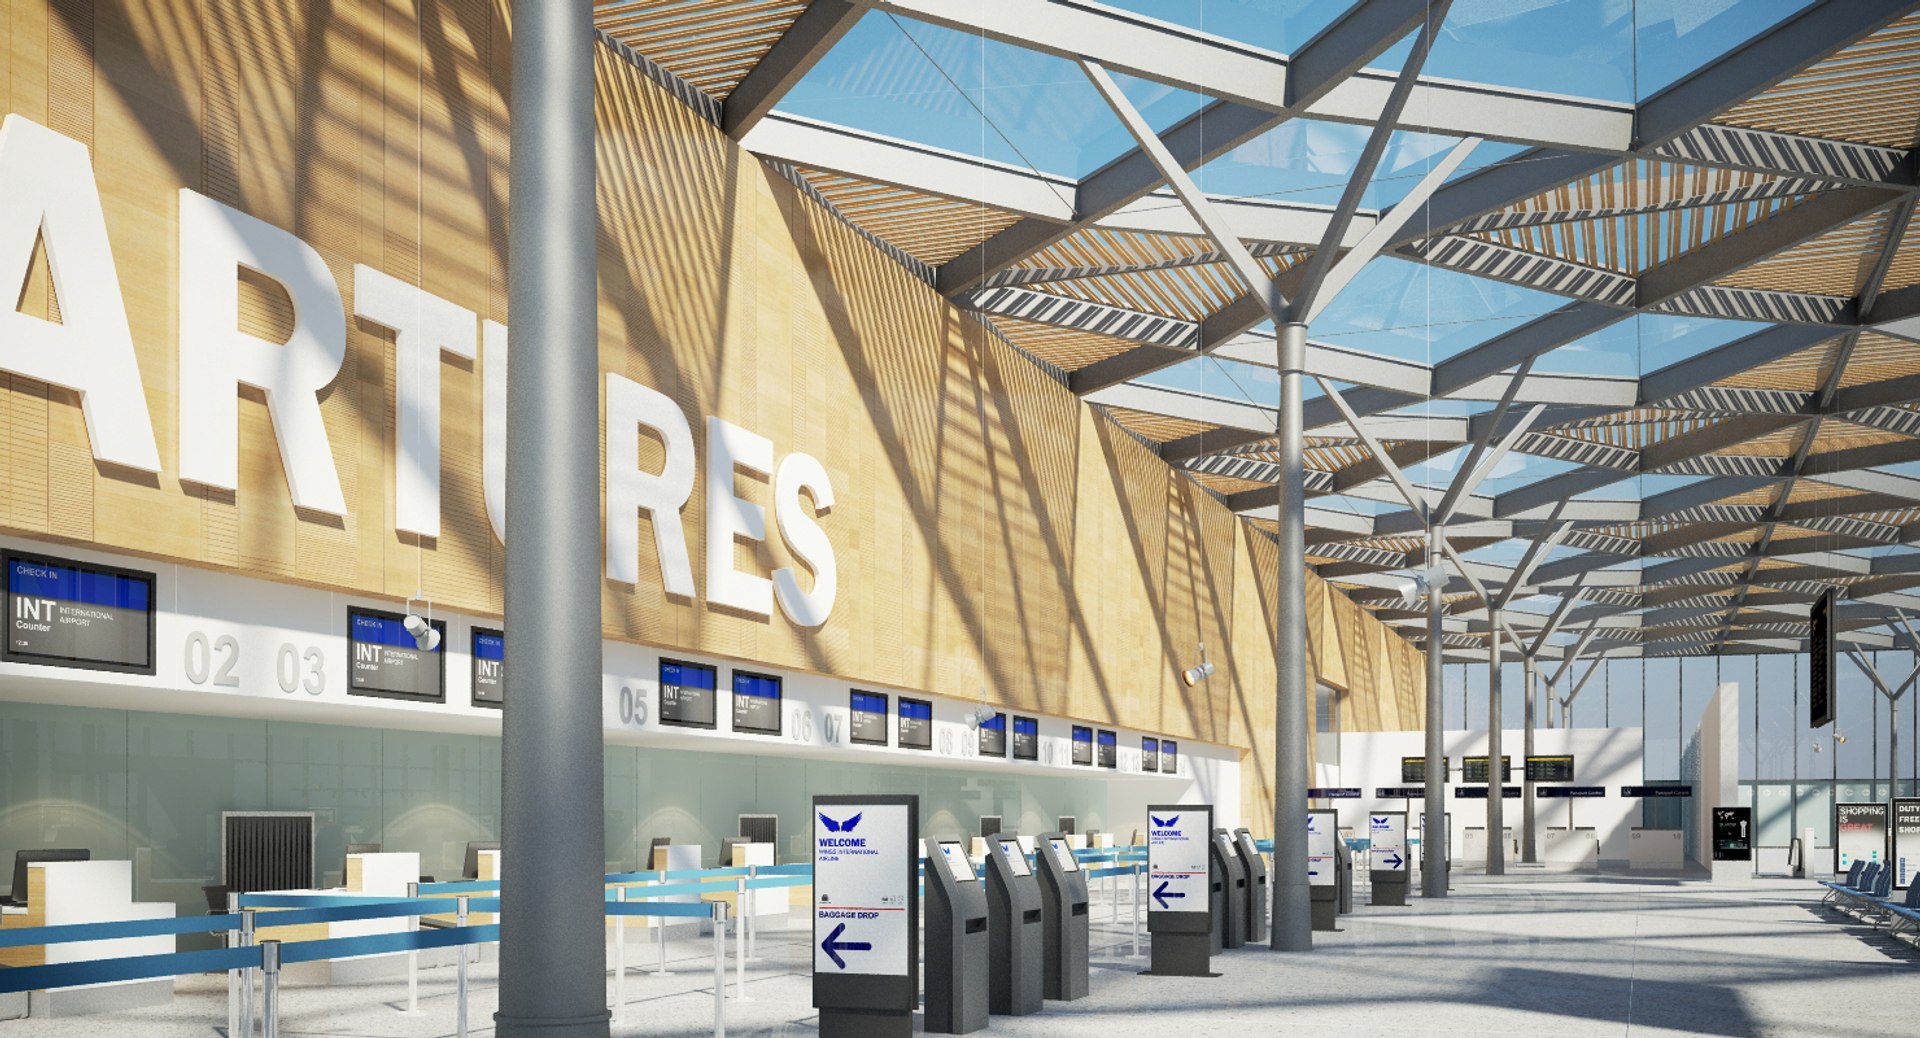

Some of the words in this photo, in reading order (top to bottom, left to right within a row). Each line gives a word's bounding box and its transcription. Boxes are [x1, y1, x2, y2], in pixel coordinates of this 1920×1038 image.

[0, 113, 838, 628] ARTRES
[17, 566, 47, 578] CHECK
[49, 571, 58, 580] IN
[16, 596, 57, 622] INT
[59, 606, 114, 621] INTERNATIONAL
[16, 620, 52, 632] Counter
[59, 616, 92, 627] AIRPORT
[184, 630, 240, 688] 02
[356, 642, 383, 662] INT
[276, 642, 326, 696] 03
[478, 659, 500, 677] INT
[664, 685, 680, 700] INT
[619, 686, 648, 726] 05
[735, 694, 750, 709] INT
[792, 707, 812, 742] 06
[824, 713, 844, 744] 07
[938, 727, 953, 755] 08
[1042, 741, 1054, 765] 10
[1840, 807, 1884, 816] SHOPPING
[1840, 815, 1849, 823] IS
[1899, 815, 1920, 823] FREE
[1839, 823, 1873, 832] GREAT
[819, 838, 866, 847] WELCOME
[819, 911, 856, 919] BAGGAGE
[857, 911, 880, 919] DROP
